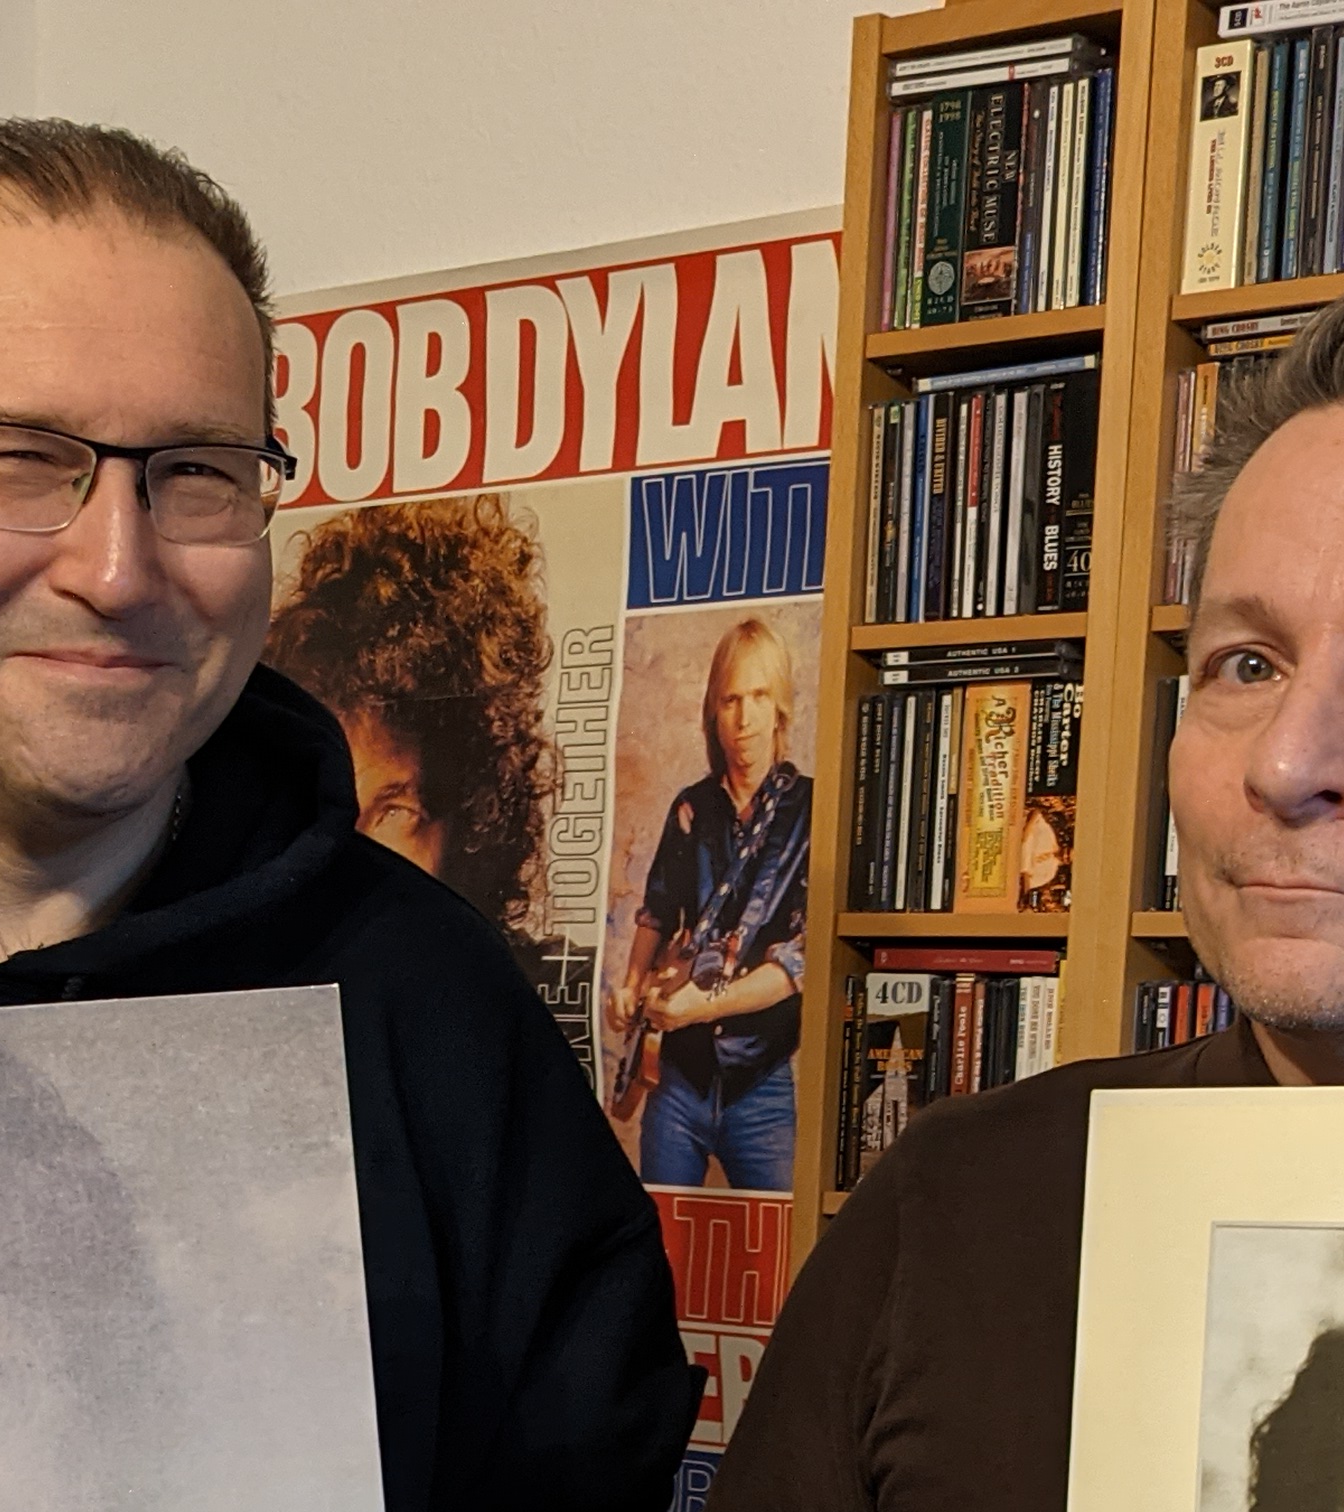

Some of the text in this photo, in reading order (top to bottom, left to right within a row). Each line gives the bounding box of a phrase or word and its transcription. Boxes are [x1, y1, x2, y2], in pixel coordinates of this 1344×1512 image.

[986, 93, 1005, 192] ELECTRIC
[1002, 151, 1017, 182] NEW
[983, 195, 999, 243] MUSE
[259, 299, 471, 504] BOB
[934, 418, 948, 454] DIVIDED
[932, 463, 946, 494] UNITED
[1043, 444, 1063, 571] HISTORY BLUES
[1066, 550, 1092, 573] 40
[946, 646, 1008, 657] AUTHENTIC USA
[947, 666, 1011, 678] AUTHENTIC USA
[980, 706, 1019, 779] Richer
[1045, 693, 1062, 787] The Mississippi Sheiks
[1059, 683, 1074, 767] Carter
[544, 625, 615, 936] TOGETHER
[986, 751, 1006, 820] Tradition
[1027, 749, 1036, 794] Brothers
[875, 981, 923, 1004] 4CD
[954, 1006, 968, 1085] Charlie Poole
[673, 1197, 793, 1325] TH
